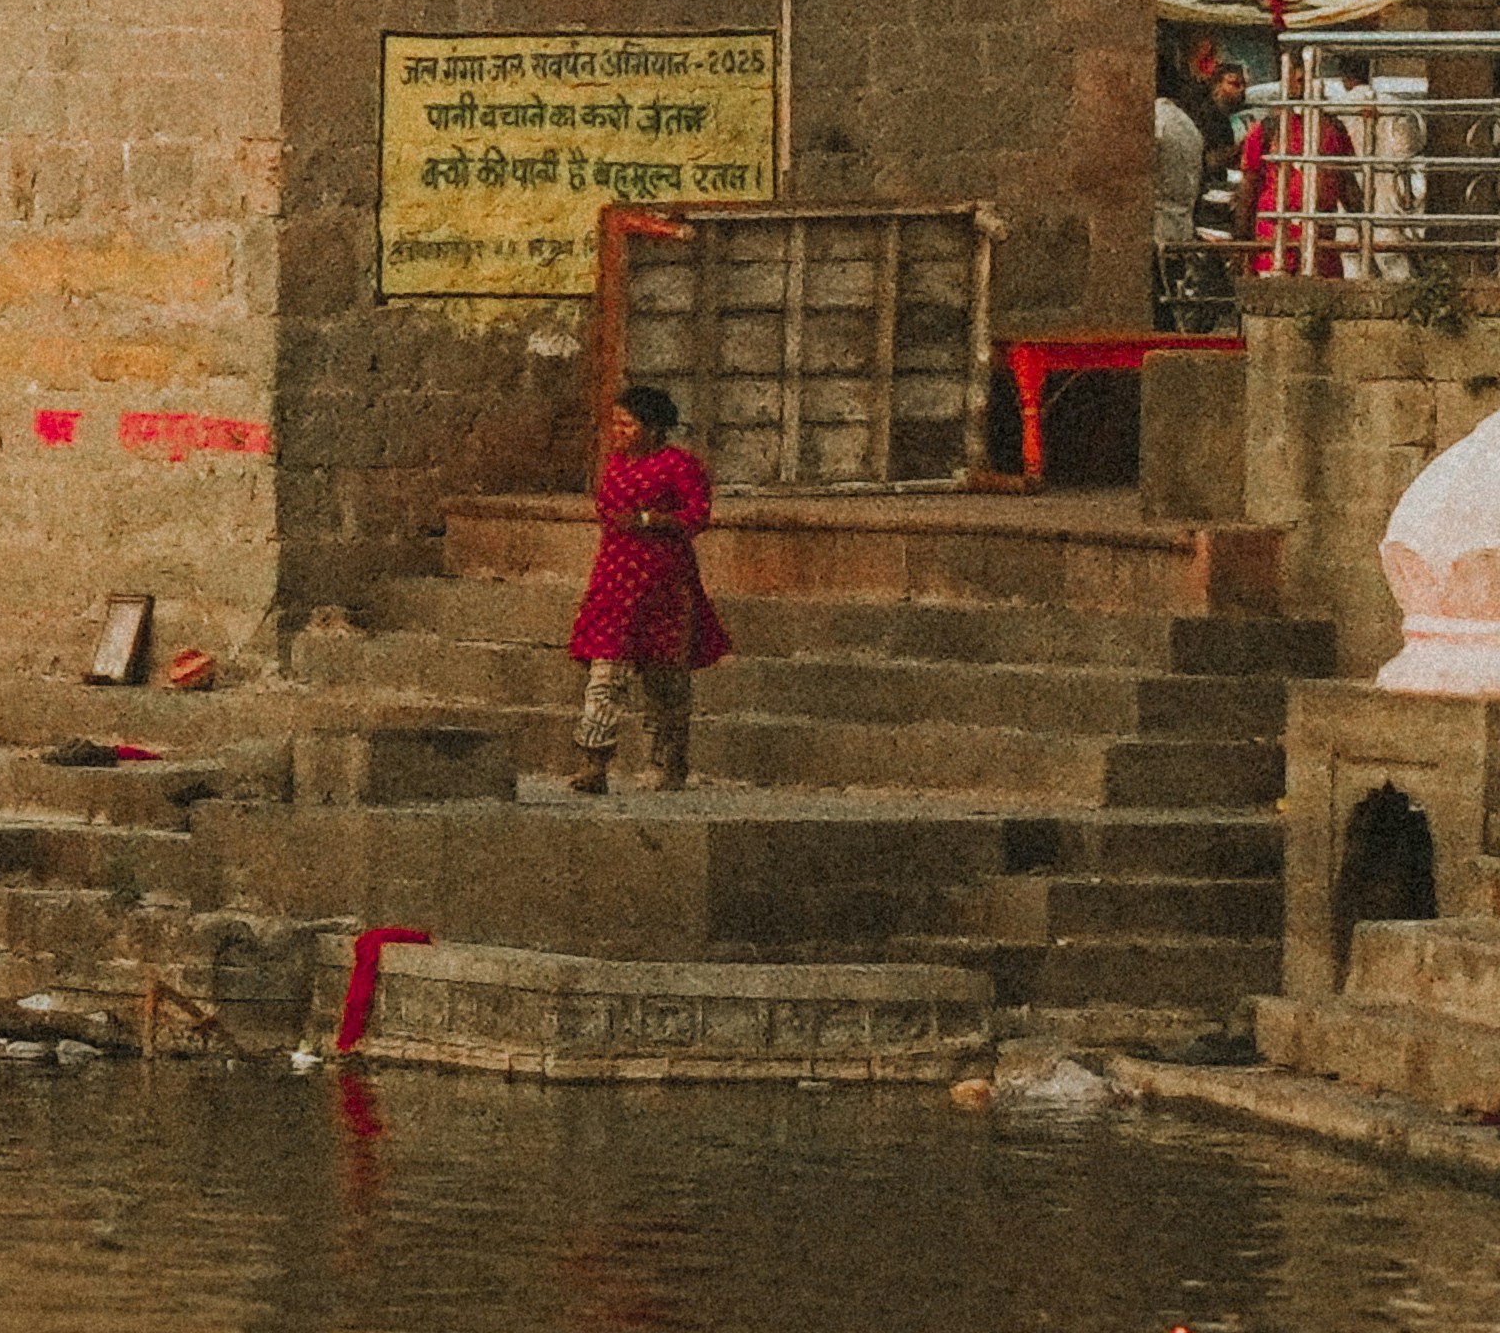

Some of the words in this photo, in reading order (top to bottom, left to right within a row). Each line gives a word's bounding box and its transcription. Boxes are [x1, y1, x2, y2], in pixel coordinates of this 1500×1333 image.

[400, 56, 439, 85] जल
[443, 45, 486, 85] गंगा
[487, 52, 526, 85] जल
[423, 90, 479, 130] पानी
[549, 104, 575, 129] का
[579, 92, 633, 131] करो
[512, 148, 559, 191] पानी
[567, 146, 590, 191] है
